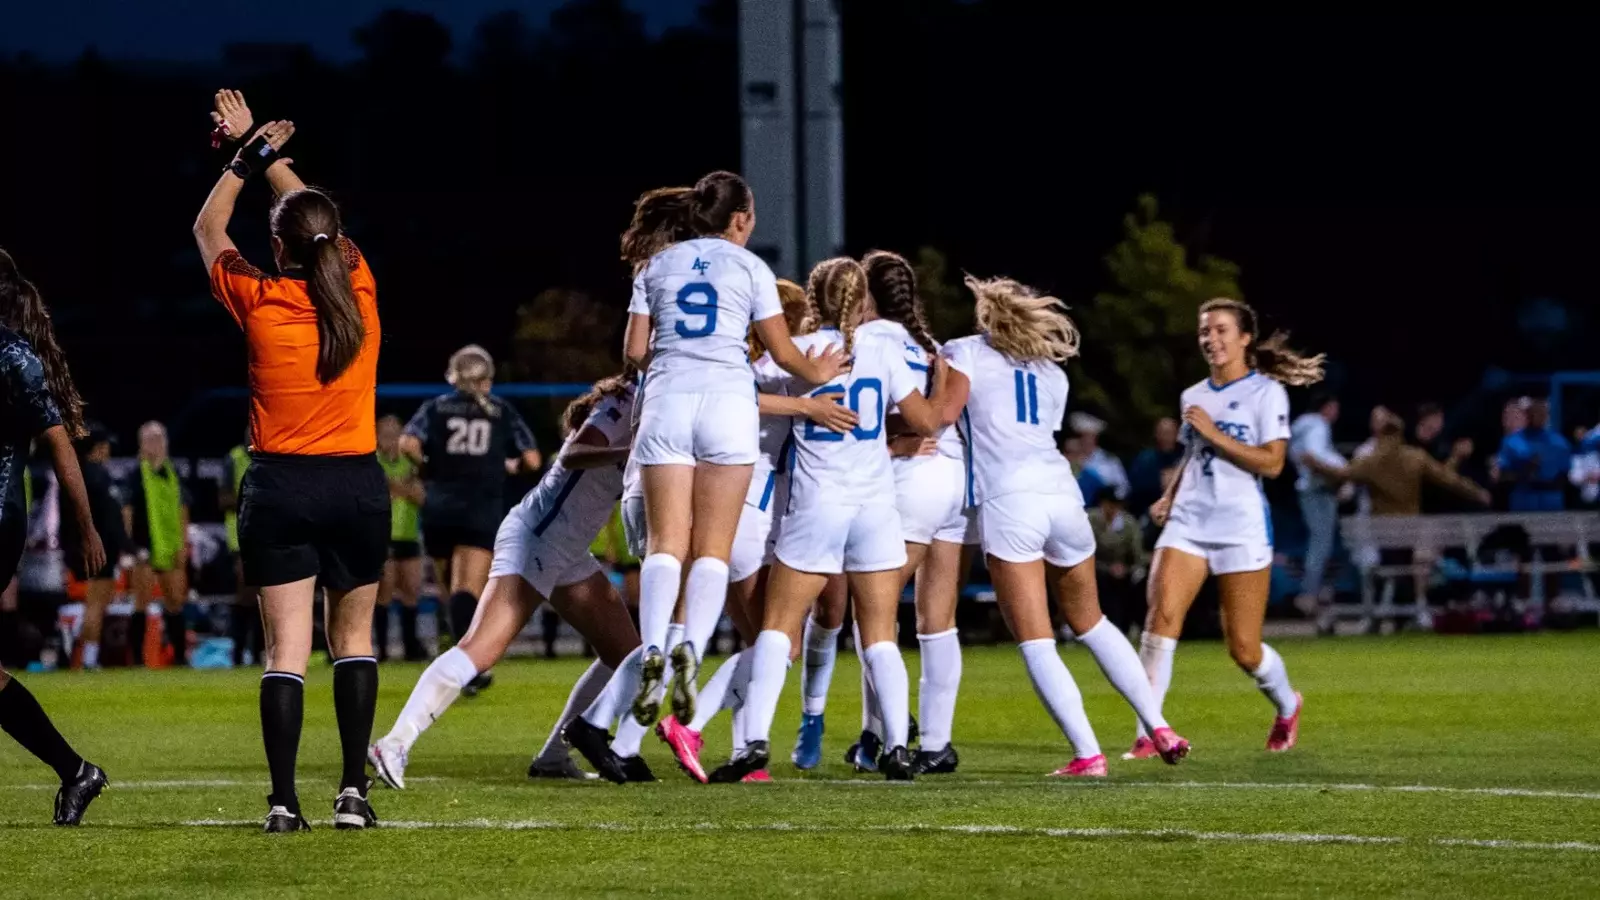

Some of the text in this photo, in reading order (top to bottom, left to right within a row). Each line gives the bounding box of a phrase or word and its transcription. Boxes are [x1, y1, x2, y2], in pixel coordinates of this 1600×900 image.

[691, 257, 711, 276] AF
[674, 282, 718, 338] 9
[1014, 369, 1039, 425] 11
[446, 416, 492, 456] 20
[1200, 446, 1216, 477] 2
